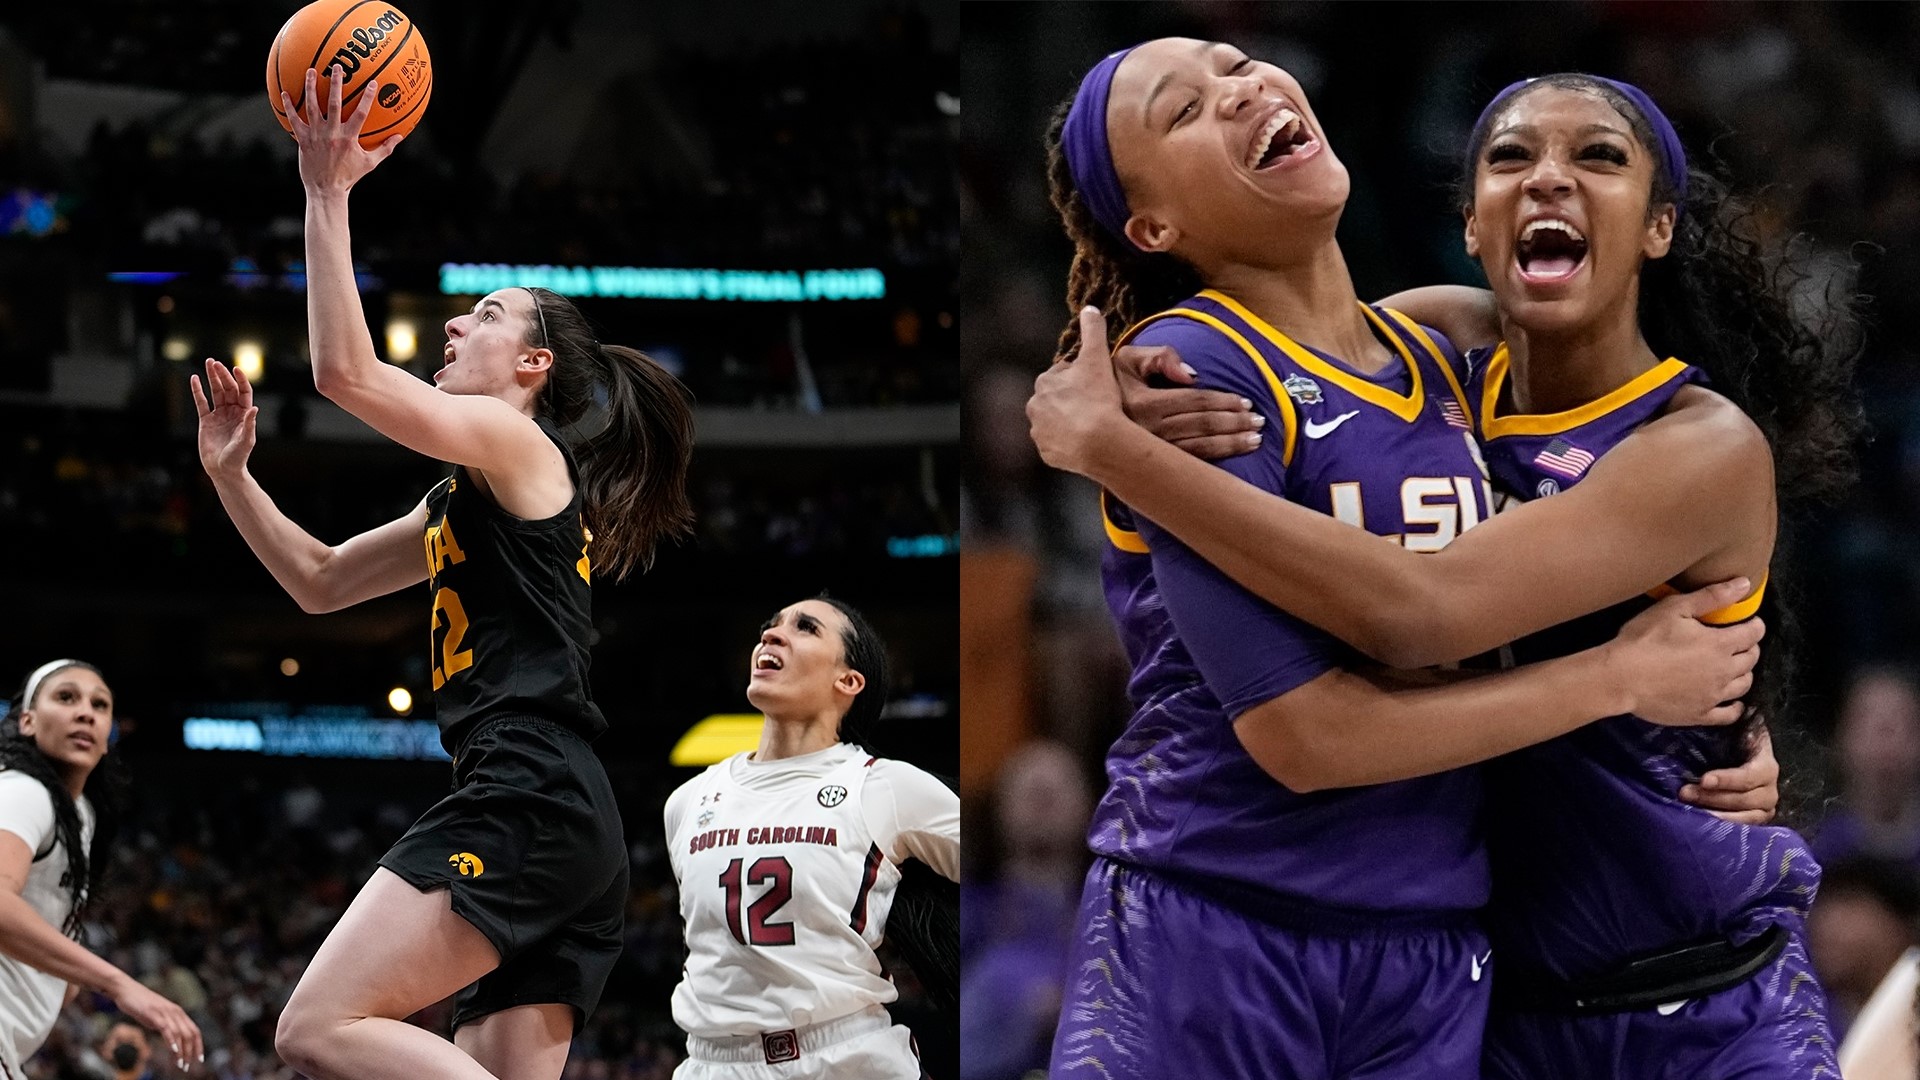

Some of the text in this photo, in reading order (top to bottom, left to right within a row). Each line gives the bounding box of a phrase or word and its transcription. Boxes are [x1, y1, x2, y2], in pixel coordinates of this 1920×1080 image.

[322, 10, 404, 85] Wilson
[382, 88, 401, 107] NCAA
[592, 266, 721, 299] WOMEN'S
[721, 269, 802, 301] FINAL
[803, 268, 886, 300] FOUR
[819, 785, 846, 808] SEC
[690, 826, 838, 855] SOUTH CAROLINA
[719, 856, 796, 946] 12
